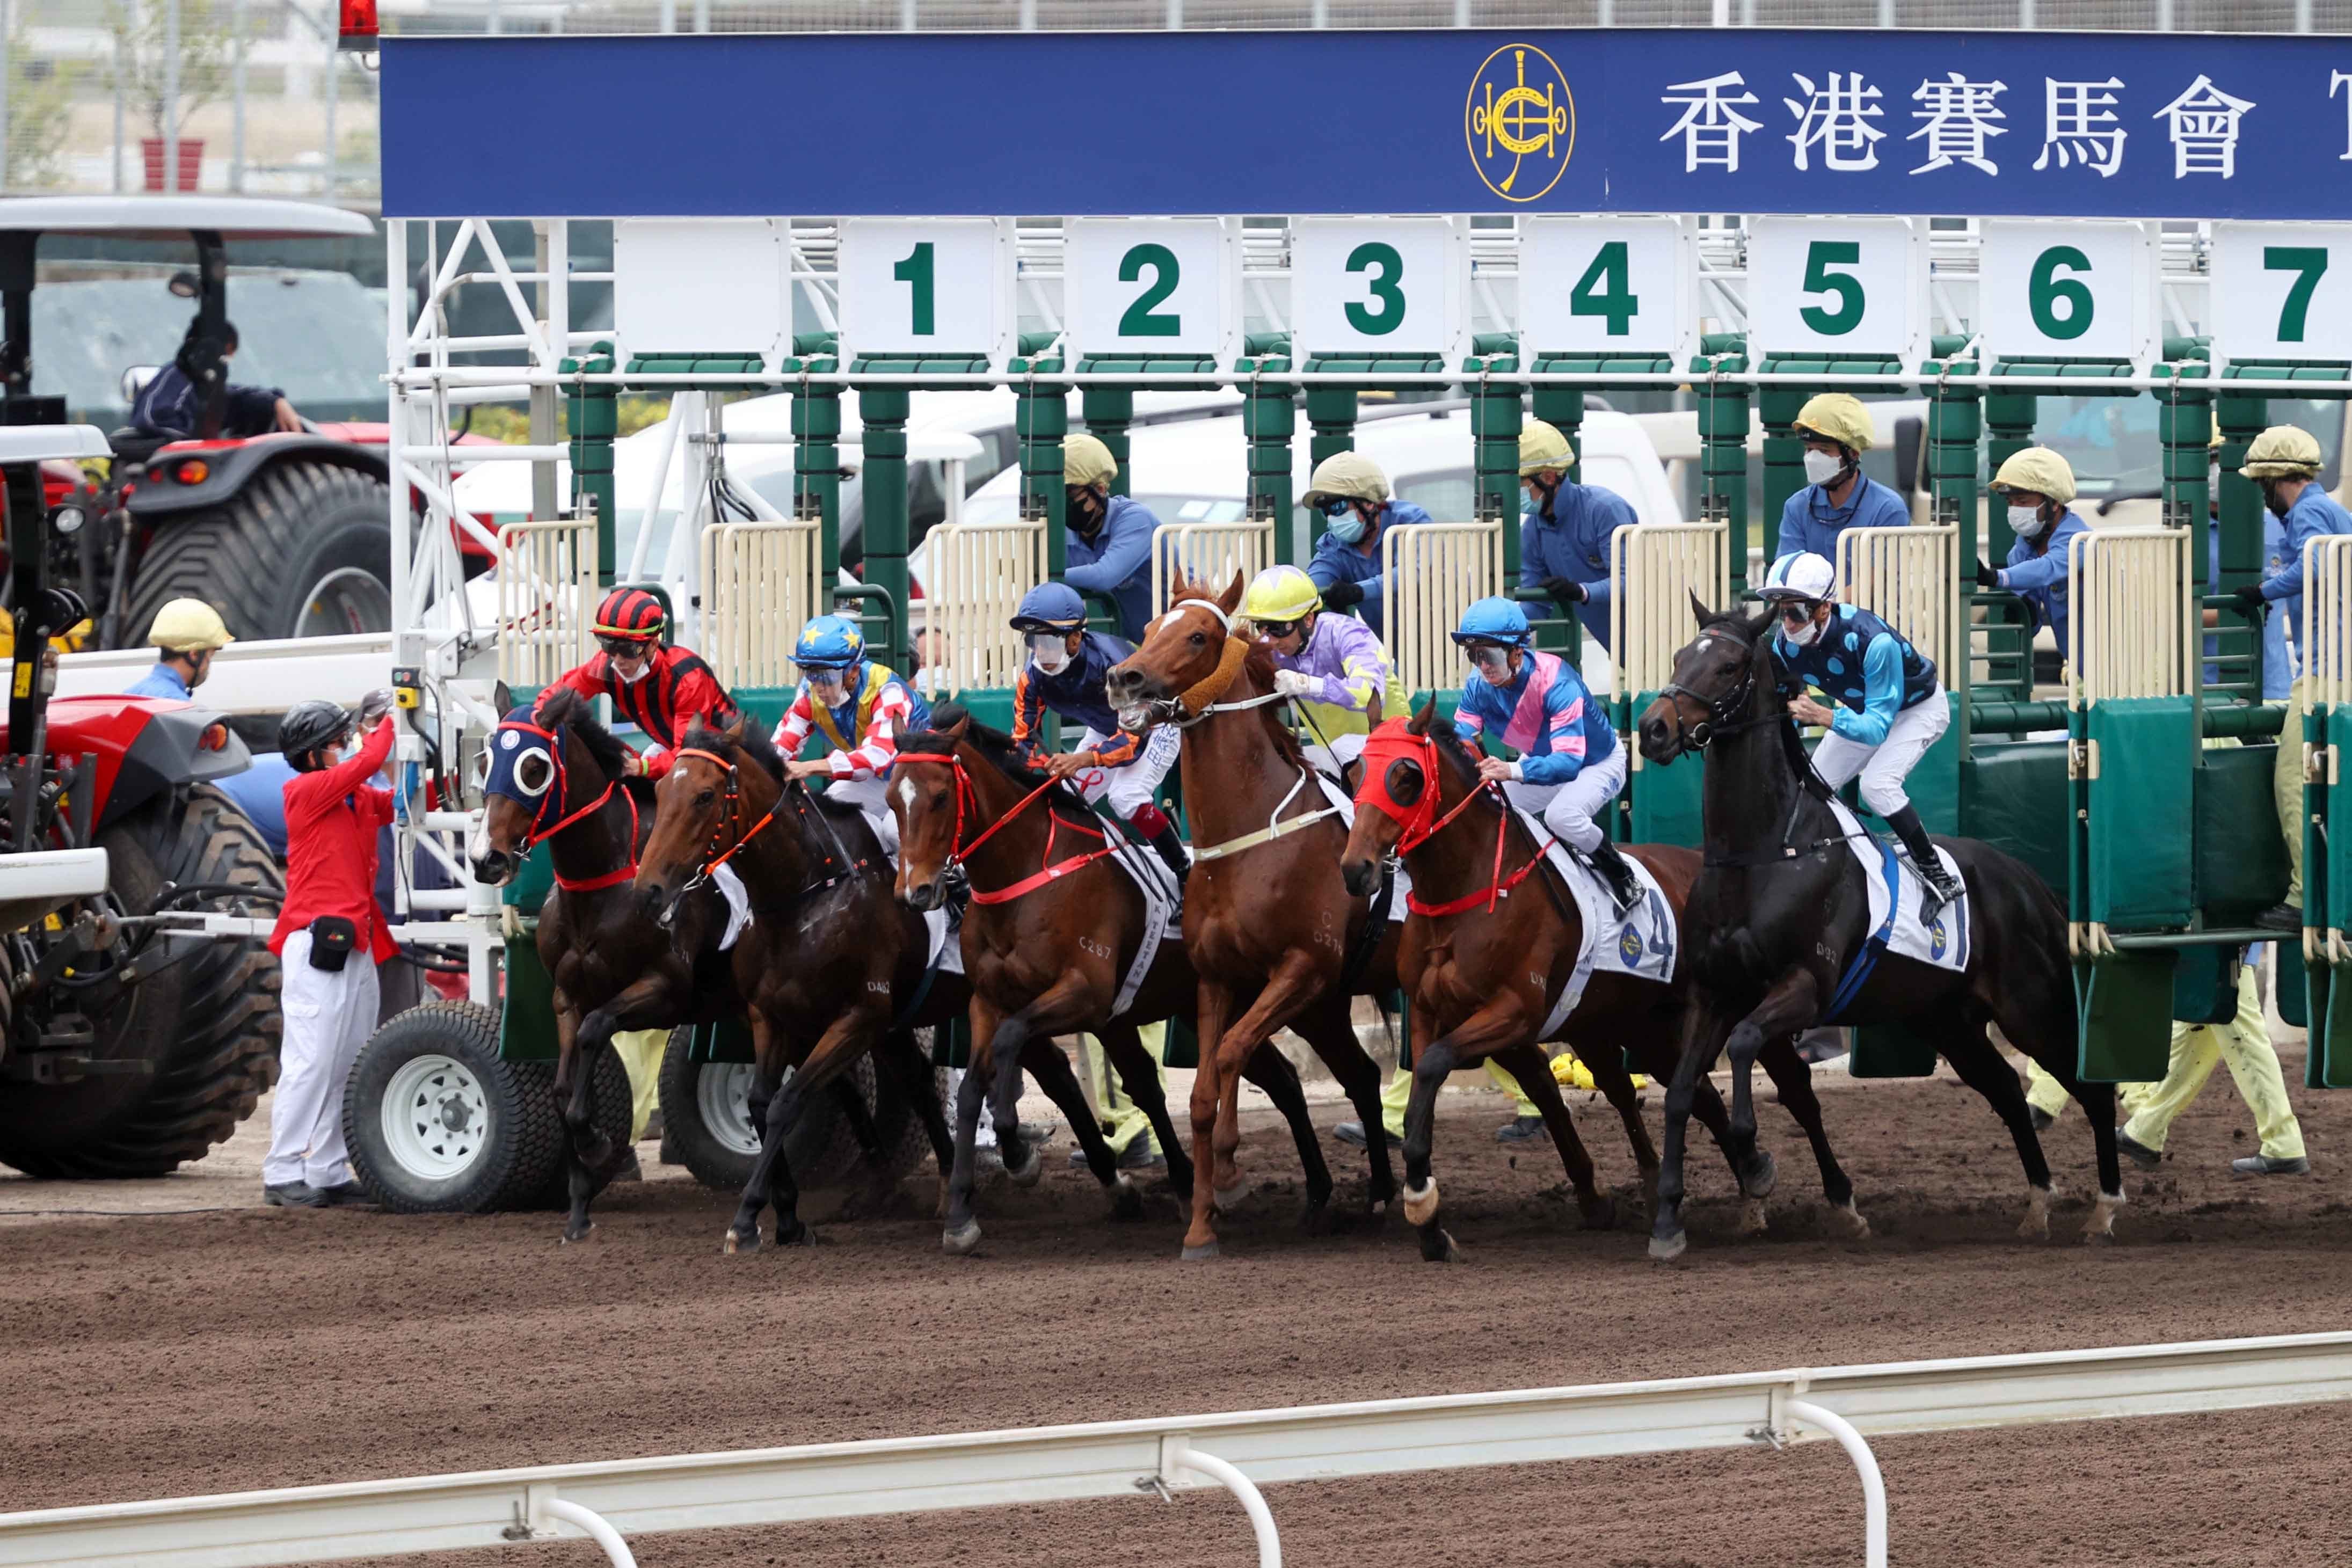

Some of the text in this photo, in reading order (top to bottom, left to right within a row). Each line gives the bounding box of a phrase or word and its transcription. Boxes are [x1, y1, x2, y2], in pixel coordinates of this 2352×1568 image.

[1659, 70, 2256, 179] 香港賽馬會
[893, 242, 935, 336] 1
[1118, 243, 1181, 337] 2
[1344, 242, 1407, 336] 3
[1570, 242, 1639, 337] 4
[1799, 242, 1866, 337] 5
[2028, 245, 2095, 340] 6
[2263, 246, 2329, 342] 7
[1079, 936, 1111, 960] C287
[1133, 921, 1159, 978] TEETAN
[1648, 887, 1674, 978] 4
